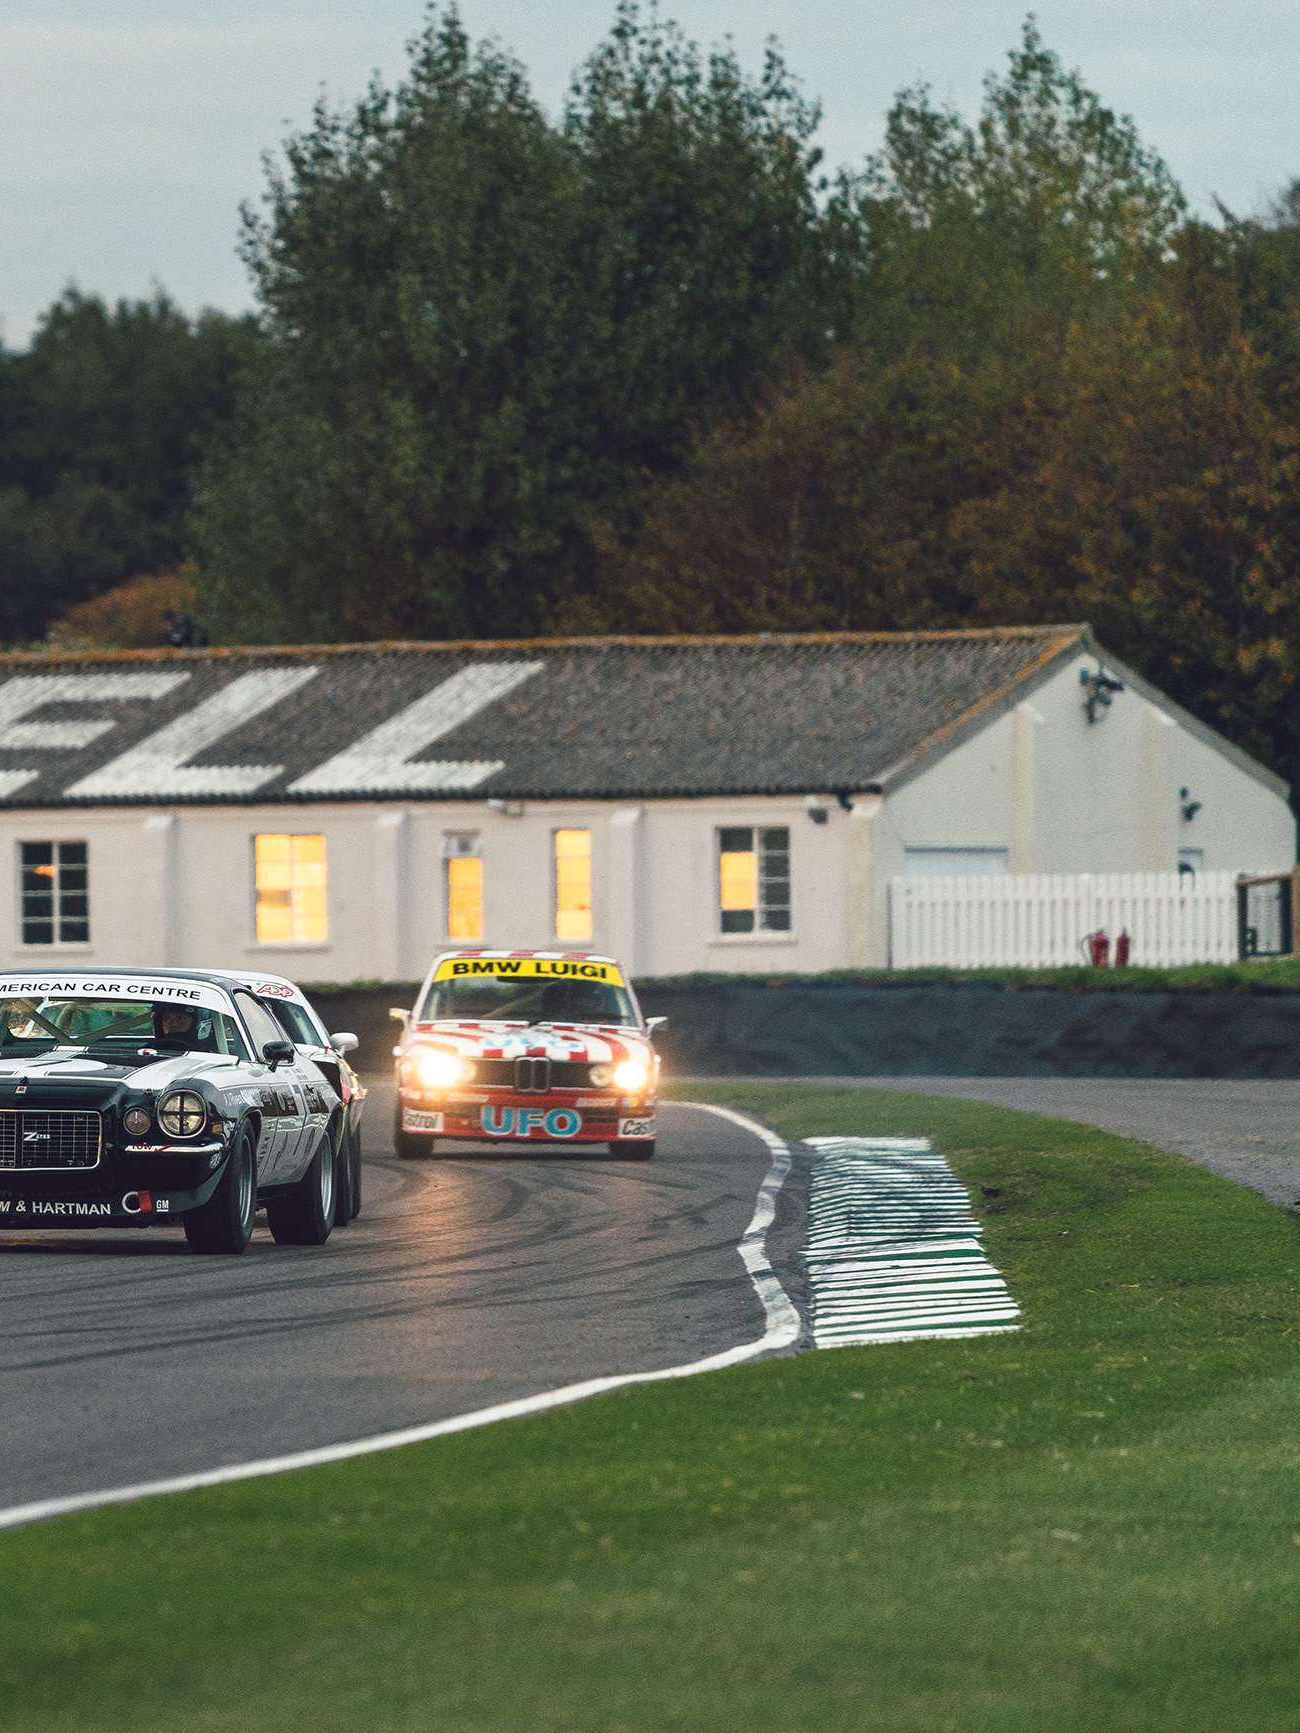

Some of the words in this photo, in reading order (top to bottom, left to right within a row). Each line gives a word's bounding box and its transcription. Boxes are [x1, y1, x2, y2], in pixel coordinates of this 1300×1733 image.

[452, 961, 521, 976] BMW
[535, 961, 607, 979] LUIGI
[82, 983, 121, 993] CAR
[126, 985, 201, 1001] CENTRE
[480, 1105, 582, 1137] UFO
[15, 1200, 27, 1212] &
[32, 1201, 111, 1215] HARTMAN
[156, 1199, 169, 1210] GM
